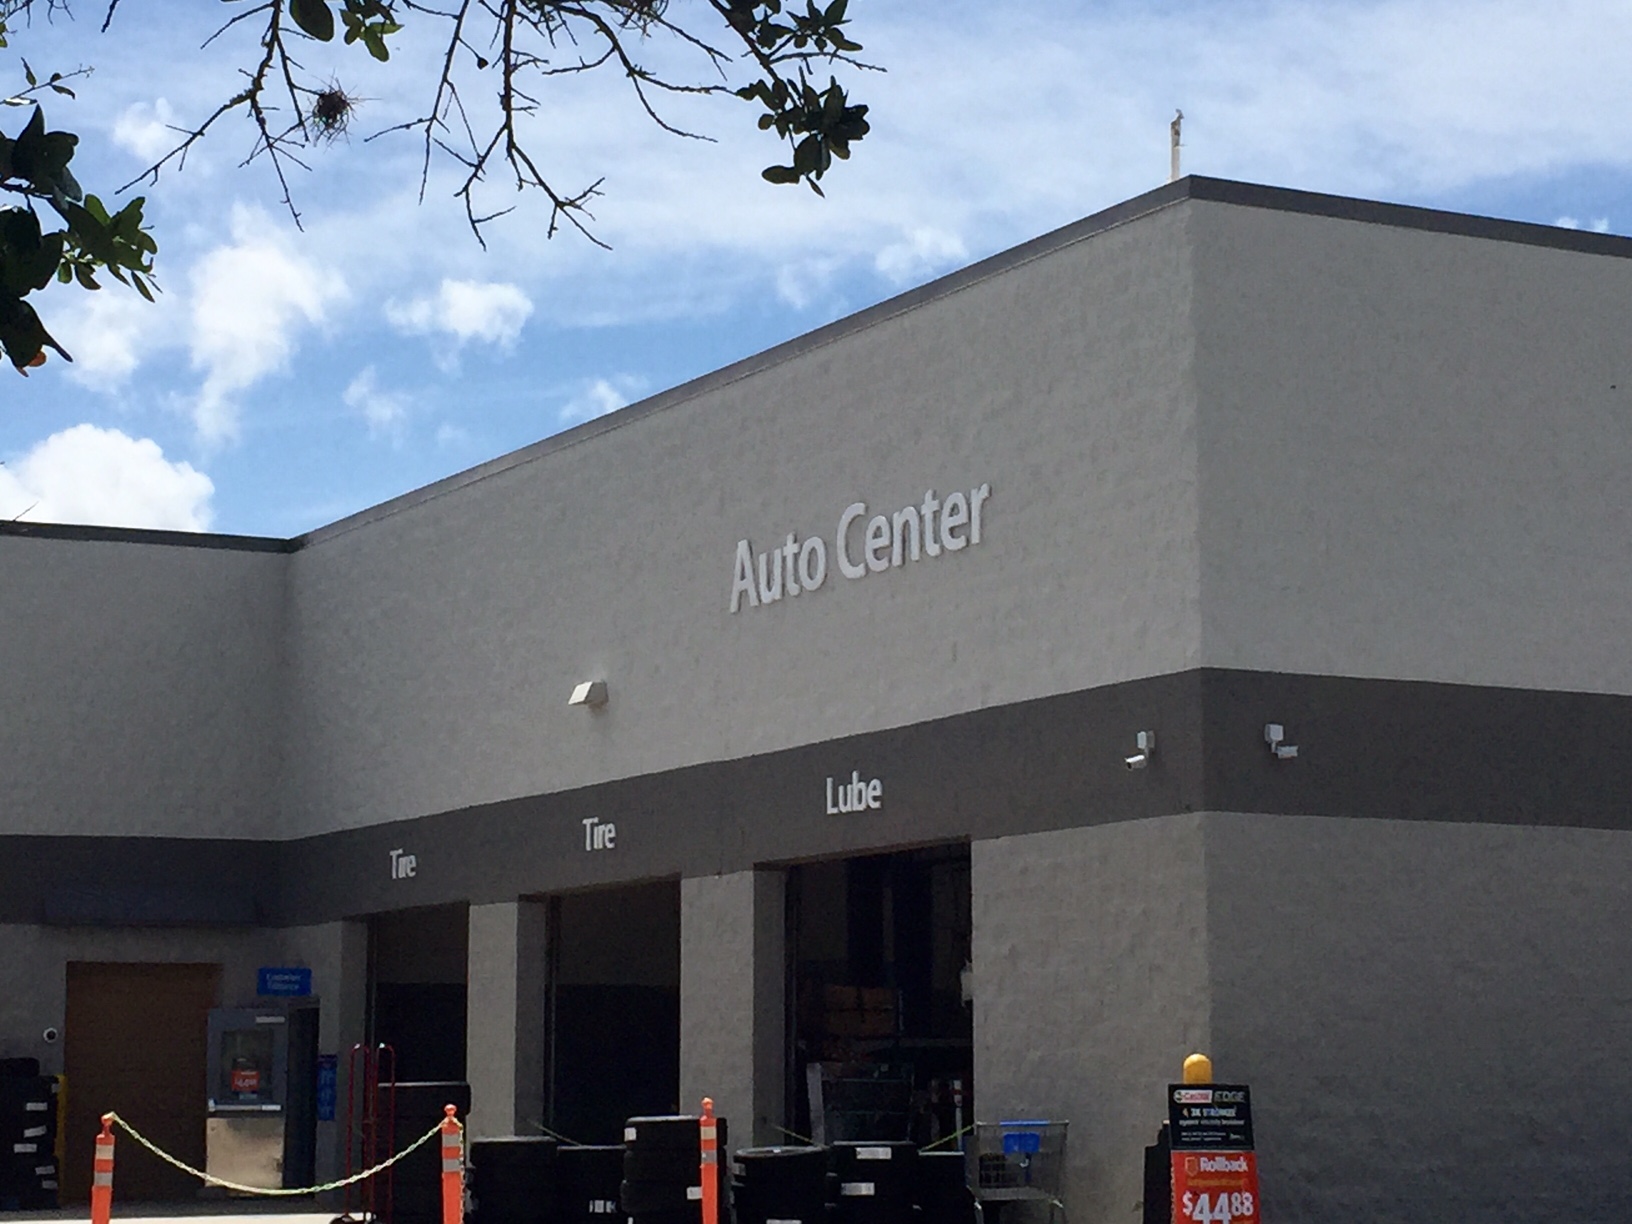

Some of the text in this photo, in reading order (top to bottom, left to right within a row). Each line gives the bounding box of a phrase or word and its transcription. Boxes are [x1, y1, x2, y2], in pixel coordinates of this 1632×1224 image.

[730, 483, 992, 614] Auto Center
[826, 771, 883, 815] Lube
[582, 817, 617, 852] Tire
[389, 847, 417, 881] Tire
[1199, 1156, 1249, 1172] Rollback
